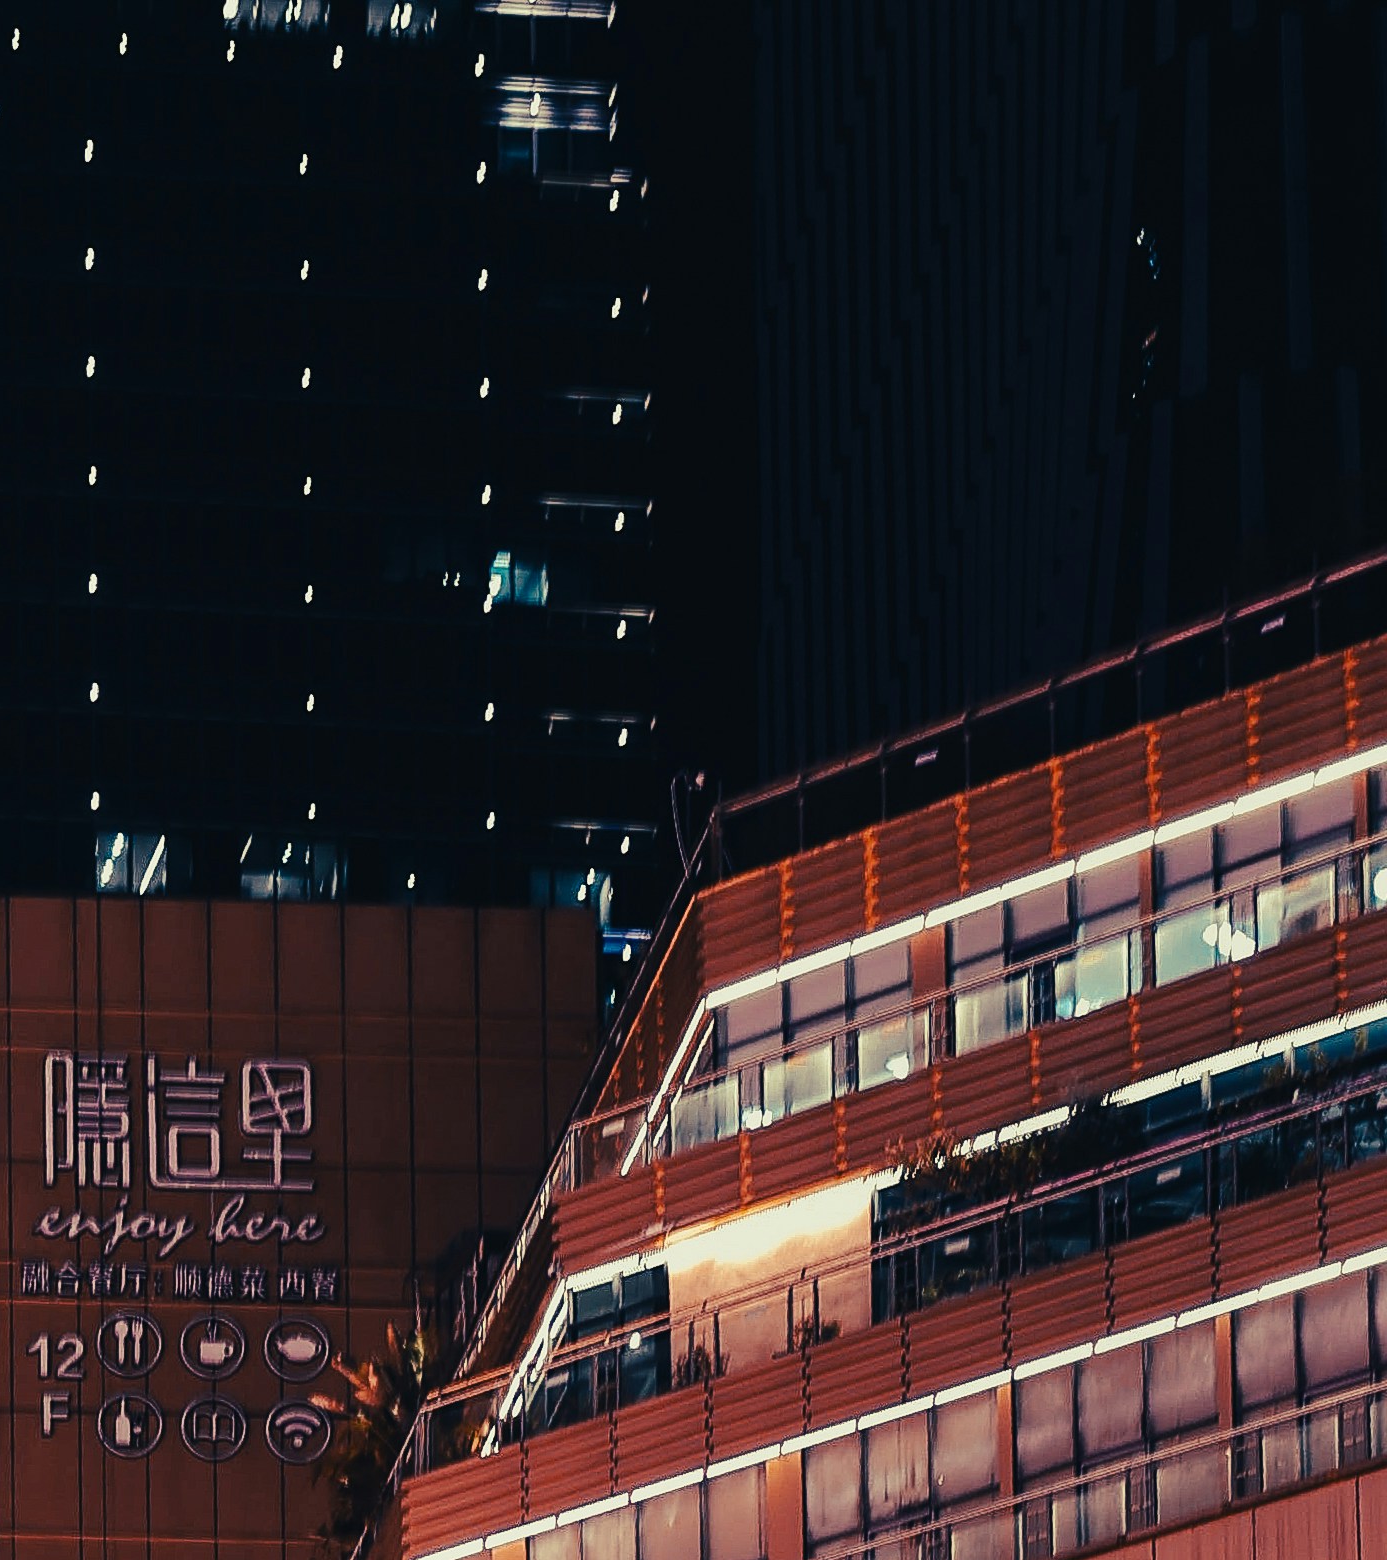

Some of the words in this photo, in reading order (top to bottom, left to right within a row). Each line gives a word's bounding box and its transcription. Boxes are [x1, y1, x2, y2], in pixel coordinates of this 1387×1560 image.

[34, 1193, 194, 1257] enjoy
[209, 1193, 326, 1244] here
[26, 1331, 85, 1379] 12
[42, 1392, 70, 1436] F
